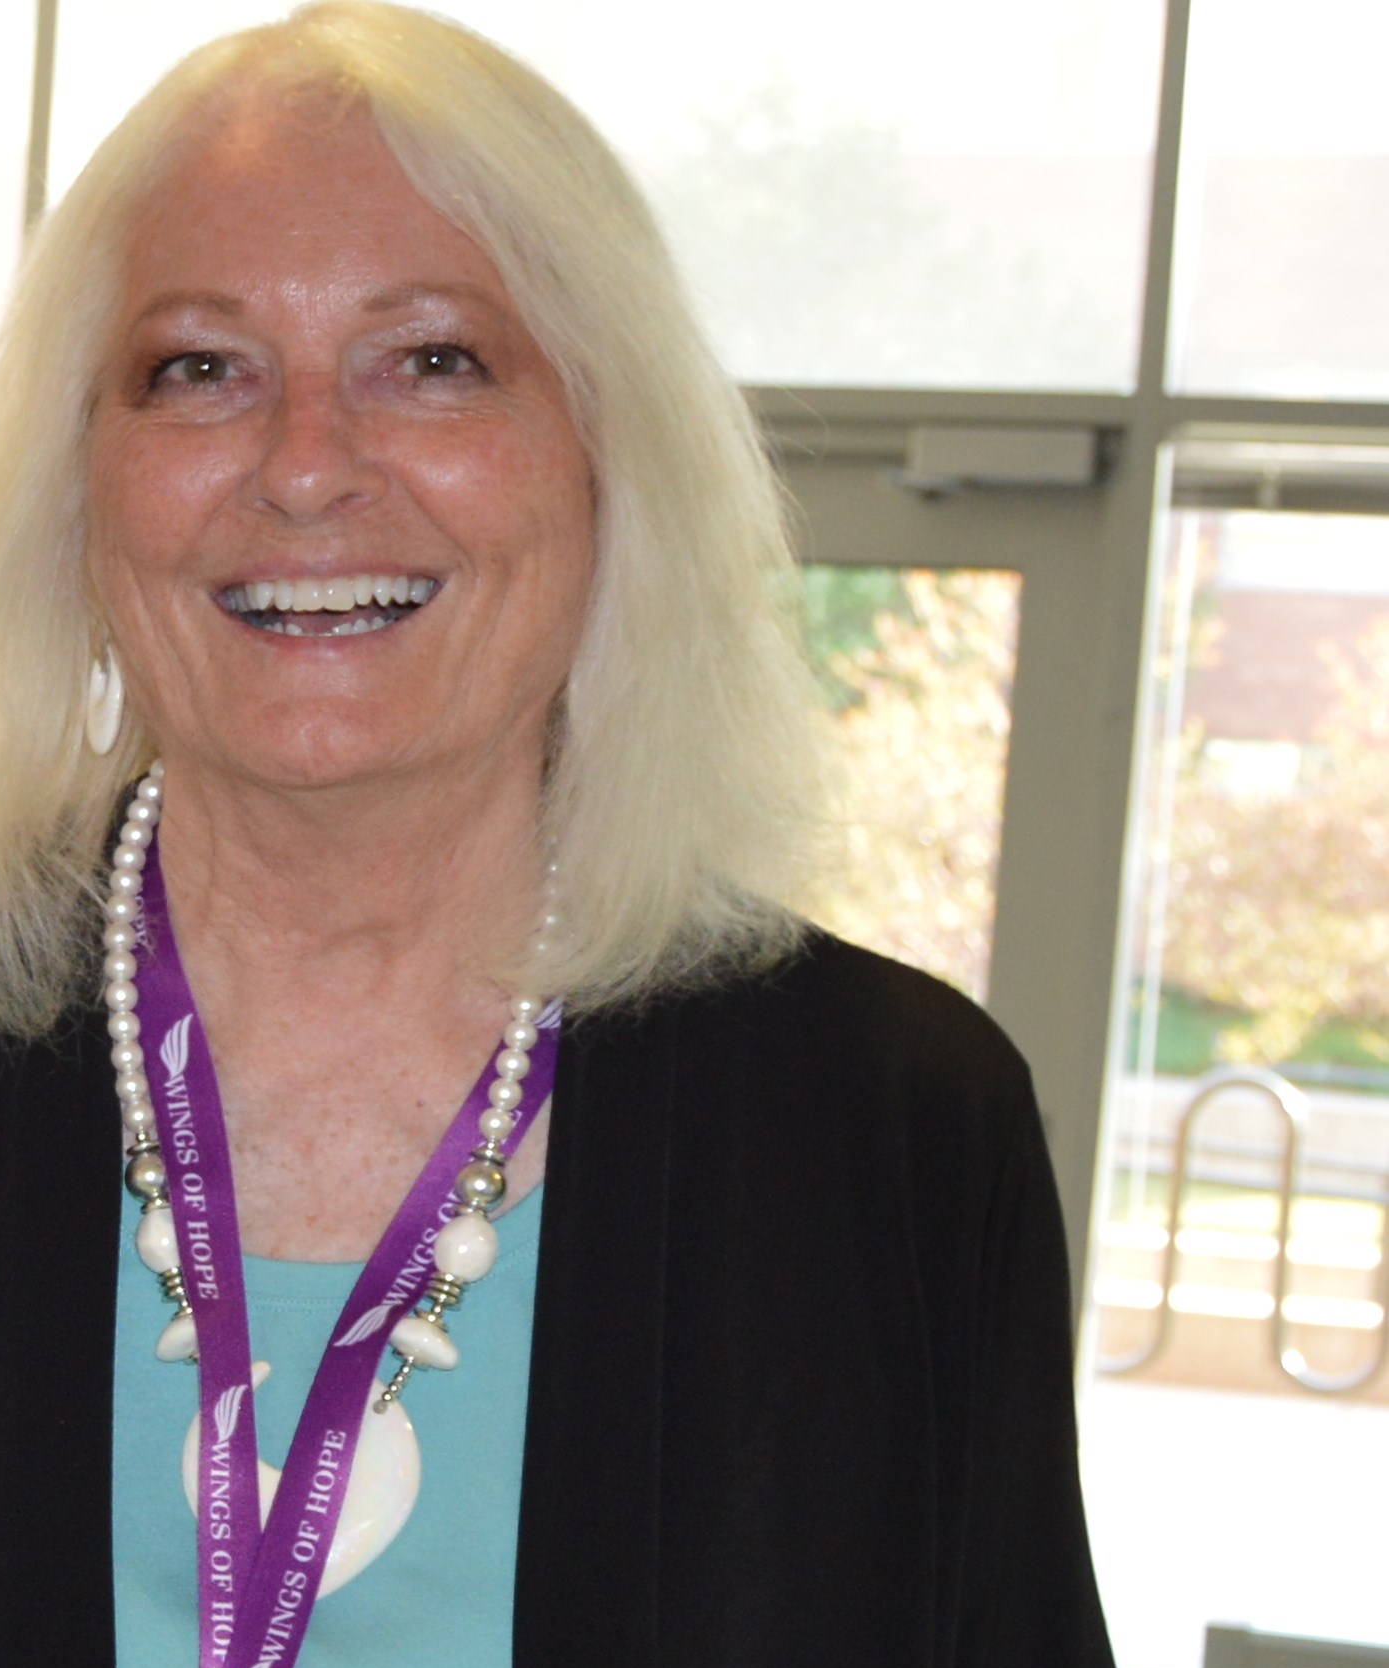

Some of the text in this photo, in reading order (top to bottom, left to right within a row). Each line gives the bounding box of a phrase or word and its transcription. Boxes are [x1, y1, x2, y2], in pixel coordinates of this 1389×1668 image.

[164, 1074, 219, 1299] WINGS OF HOPE
[210, 1441, 231, 1540] WINGS
[211, 1550, 233, 1592] OF
[259, 1429, 347, 1663] WINGS OF HOPE
